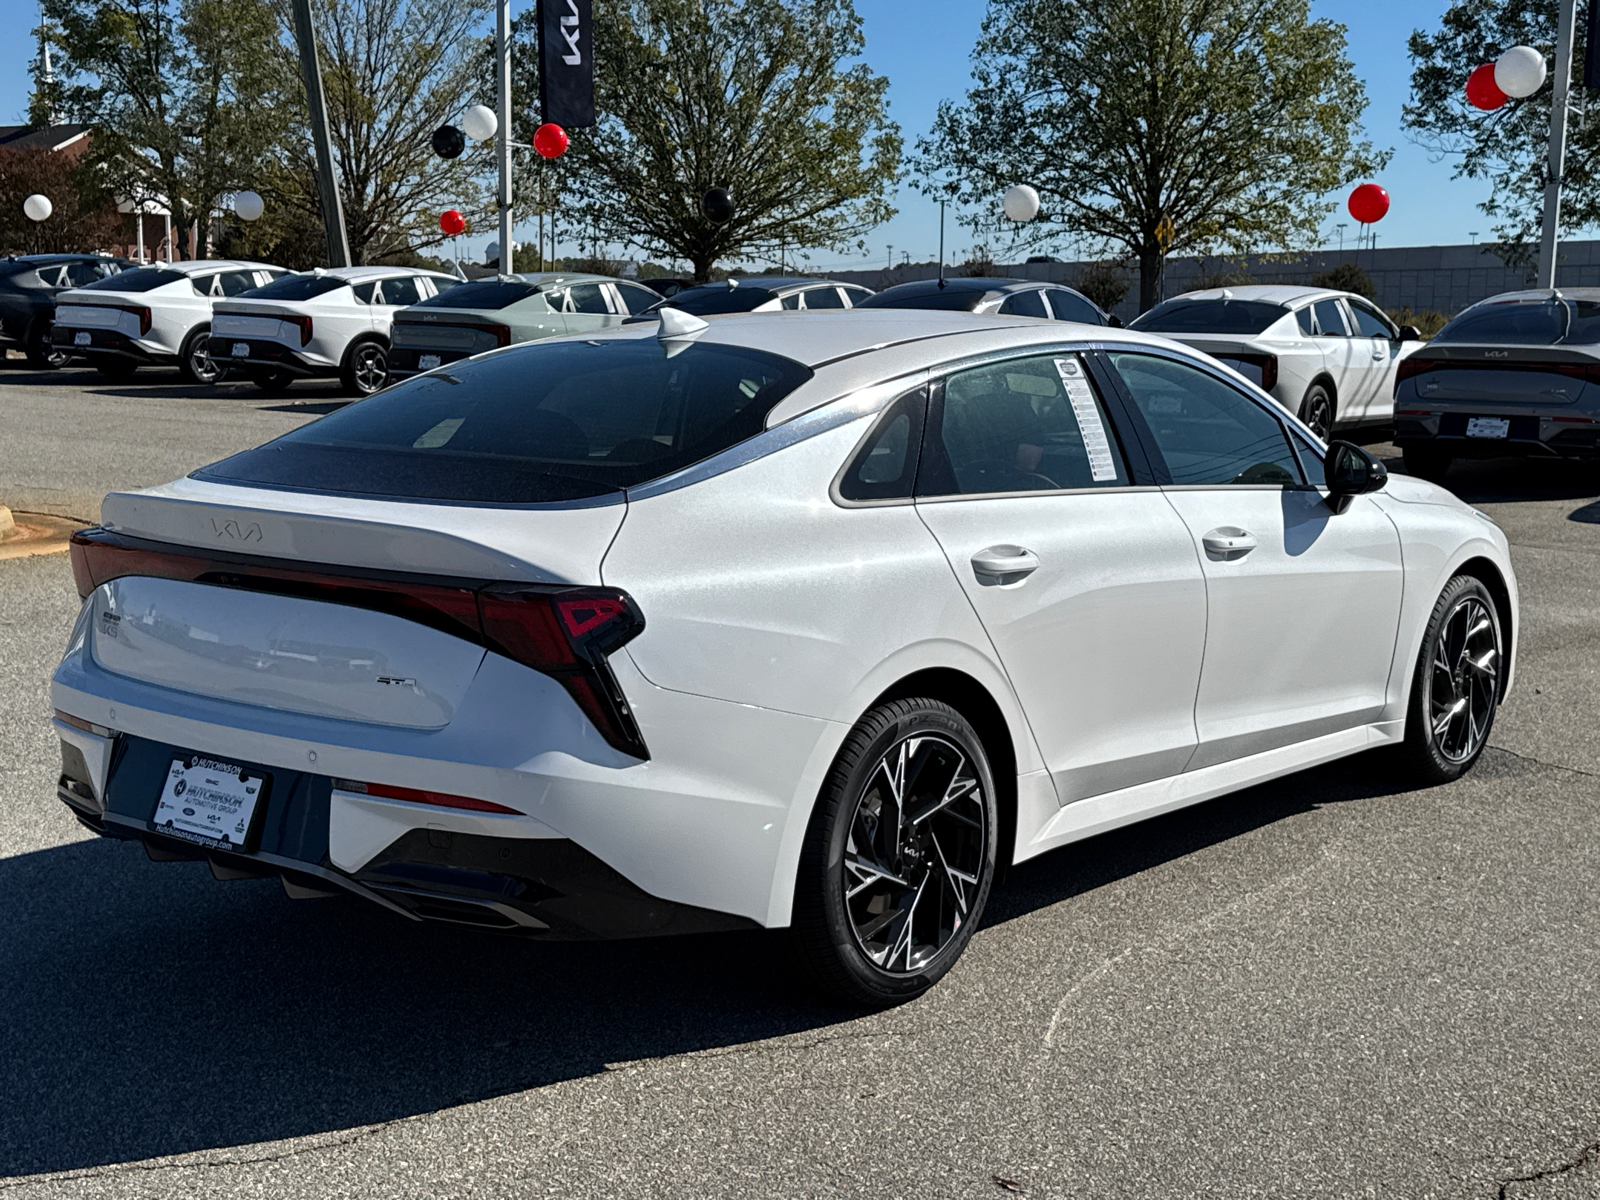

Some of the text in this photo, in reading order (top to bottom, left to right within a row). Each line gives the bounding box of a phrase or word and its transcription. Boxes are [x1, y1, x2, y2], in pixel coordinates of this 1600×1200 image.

[210, 517, 263, 542] KIA
[172, 768, 185, 776] KIA
[199, 757, 243, 775] HUTCHINSON
[184, 797, 218, 810] AUTOMOTIVE
[218, 804, 238, 815] GROUP
[186, 787, 244, 808] HUTCHINSON
[207, 814, 221, 822] KIA
[155, 824, 233, 851] Hutchinsonautogroup.com
[903, 846, 920, 859] KIA
